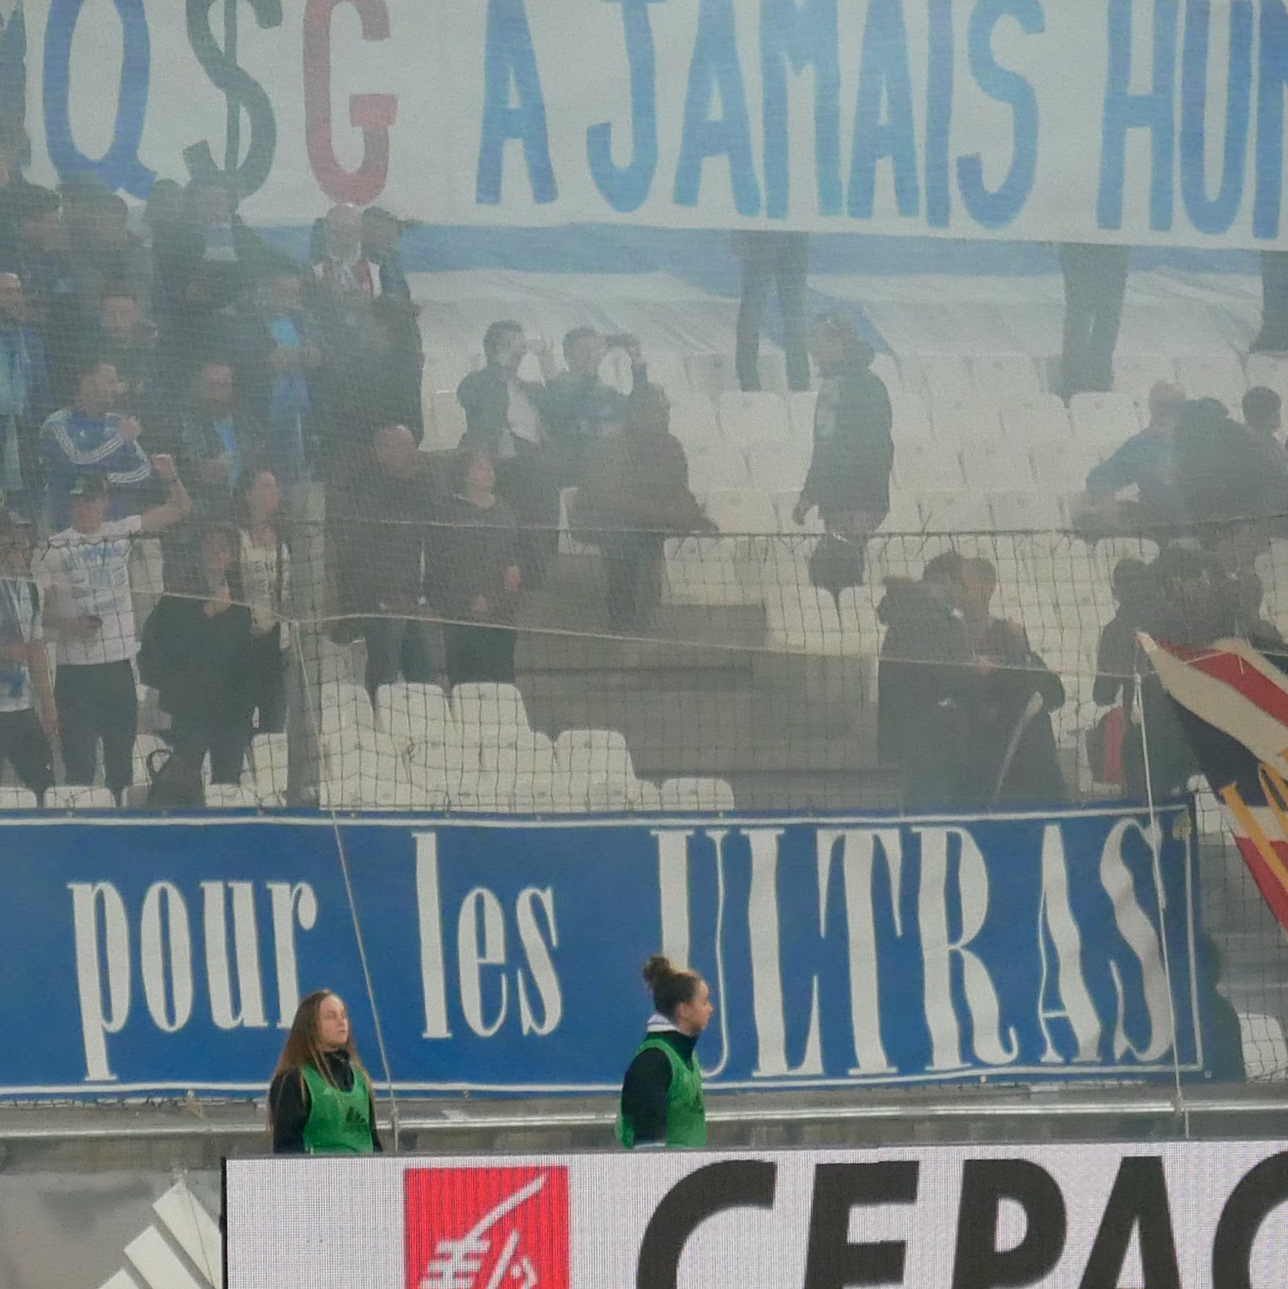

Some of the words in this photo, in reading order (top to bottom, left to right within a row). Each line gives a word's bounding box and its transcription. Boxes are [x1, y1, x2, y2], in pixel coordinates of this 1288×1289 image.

[68, 879, 318, 1082] pour
[411, 832, 563, 1039] les
[650, 818, 1175, 1078] ULTRAS
